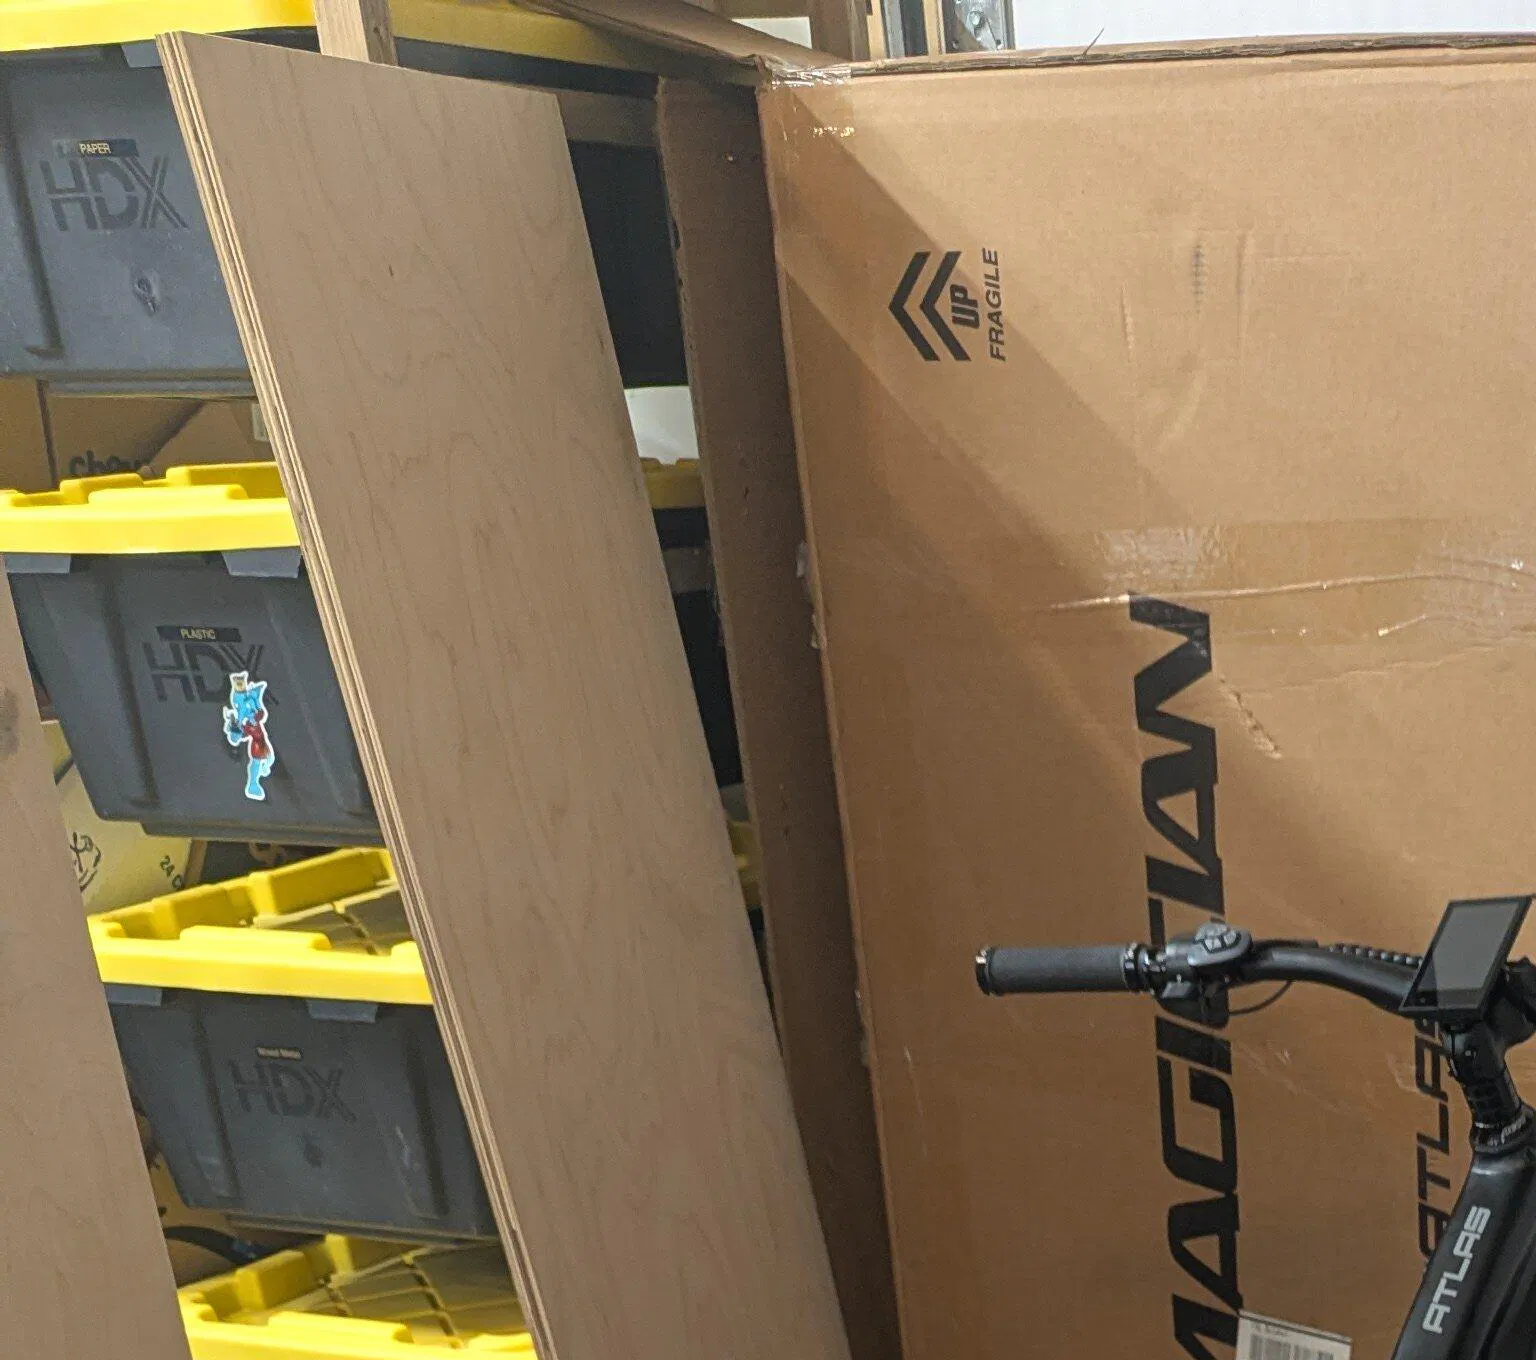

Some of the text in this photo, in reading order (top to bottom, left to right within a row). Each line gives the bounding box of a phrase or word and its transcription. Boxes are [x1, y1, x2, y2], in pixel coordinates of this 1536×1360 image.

[78, 142, 112, 155] PAPER
[39, 155, 189, 232] HDX
[949, 284, 980, 329] UP
[982, 247, 1006, 362] FRAGILE
[180, 628, 216, 641] PLASTIC
[228, 1060, 357, 1122] HDX
[1422, 1205, 1491, 1334] ATLAS
